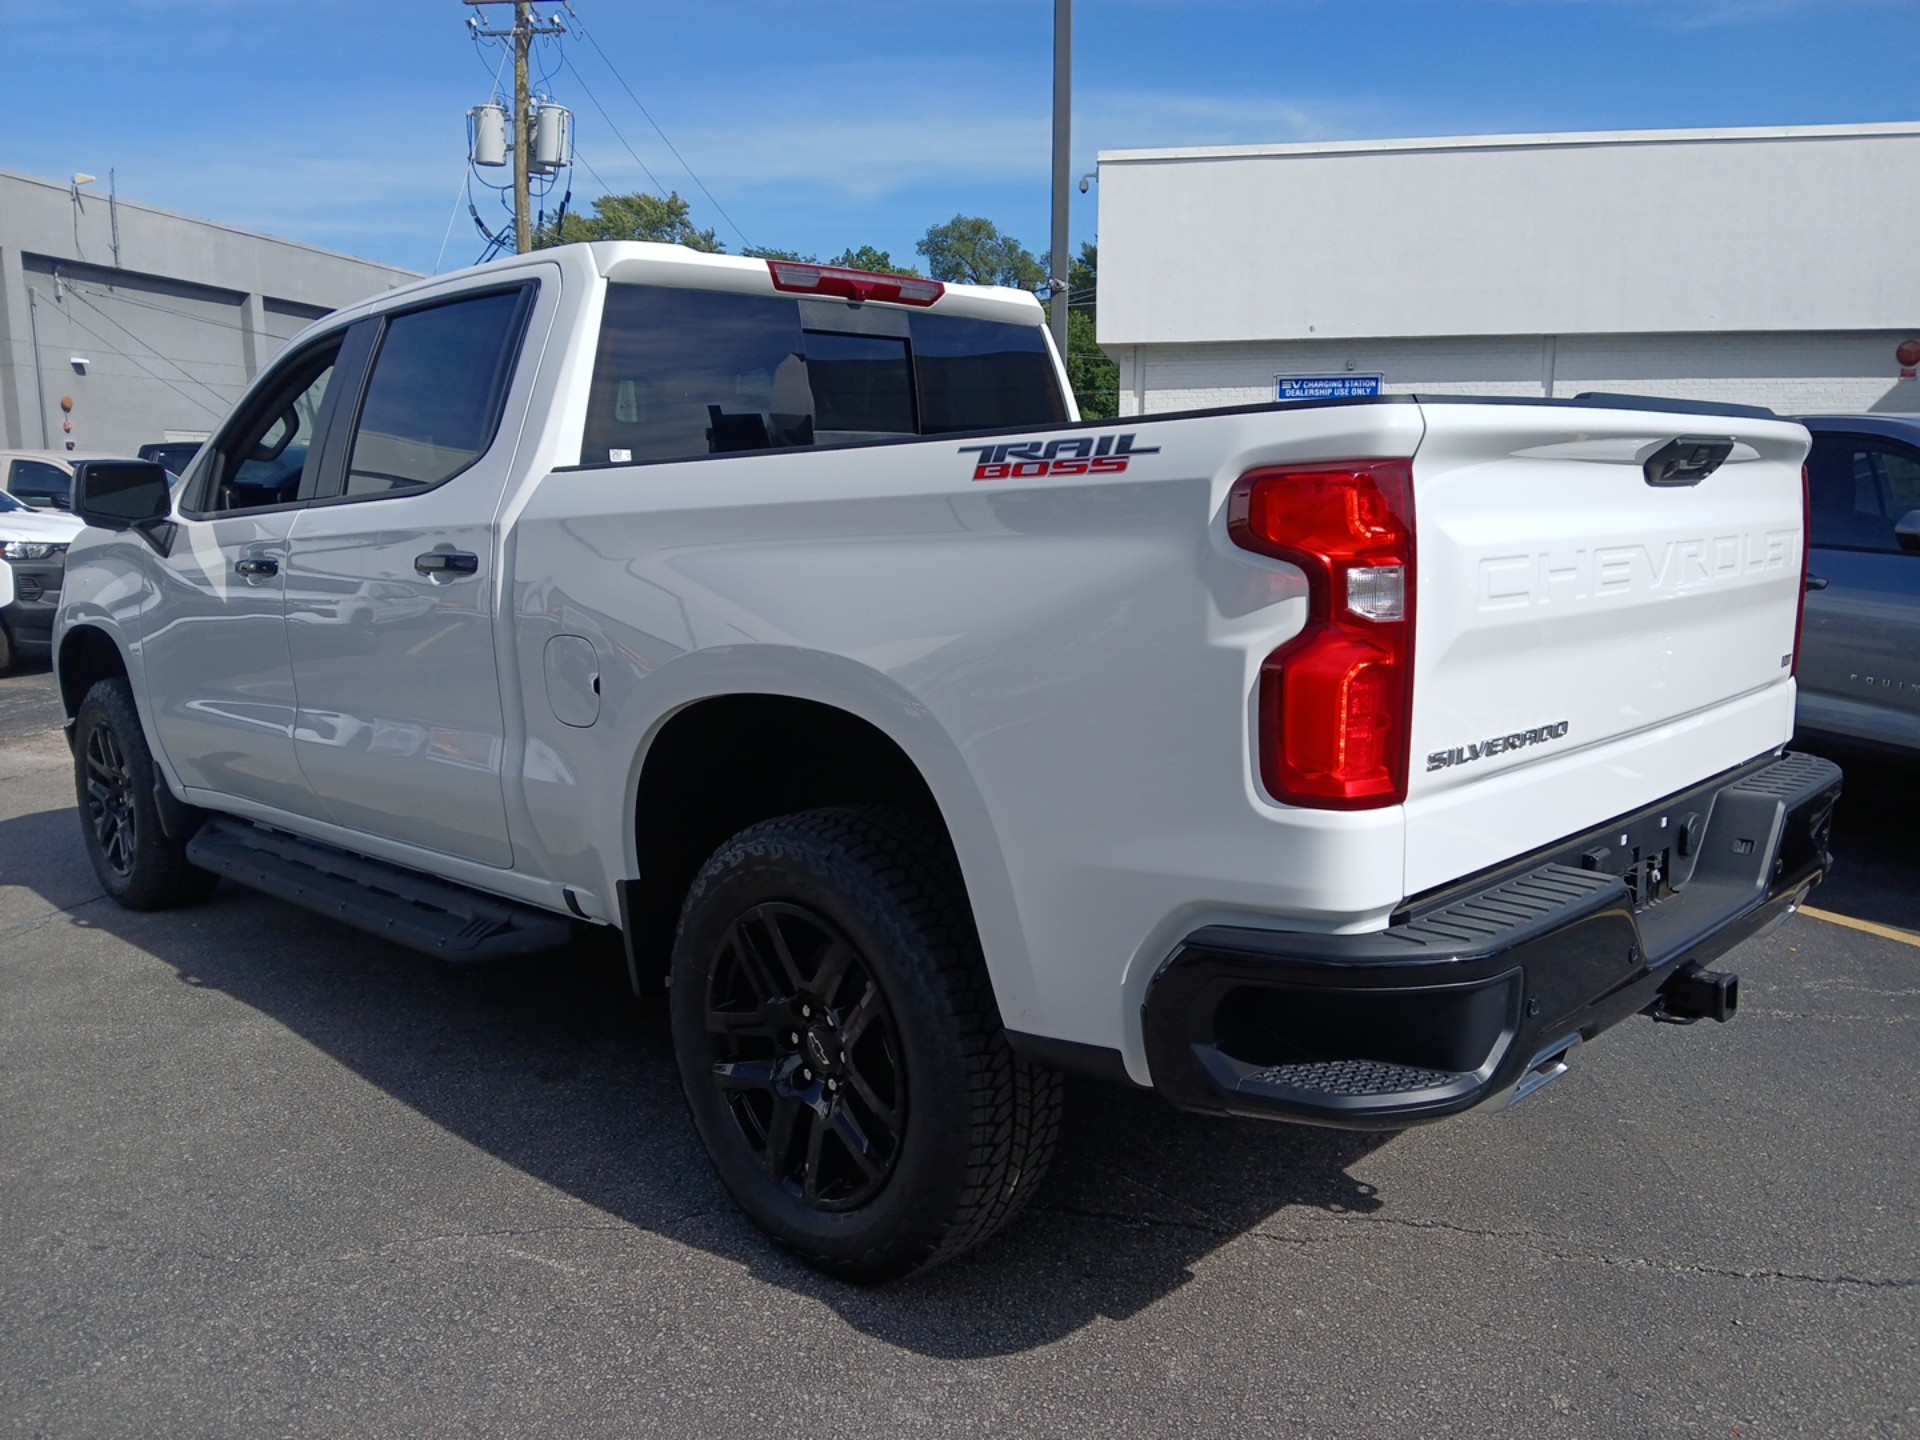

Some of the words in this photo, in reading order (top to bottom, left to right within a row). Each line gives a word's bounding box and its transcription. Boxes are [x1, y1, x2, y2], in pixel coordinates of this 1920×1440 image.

[1281, 380, 1302, 389] EV
[1303, 380, 1342, 388] CHARGING
[1345, 379, 1376, 387] STATION
[1285, 388, 1332, 397] DEALERSHIP
[1334, 388, 1349, 396] USE
[1351, 387, 1371, 396] ONLY
[958, 433, 1162, 464] TRAIL
[972, 456, 1129, 481] BOSS
[1477, 528, 1800, 612] CHEVROLET
[1426, 720, 1568, 772] SILVERADO
